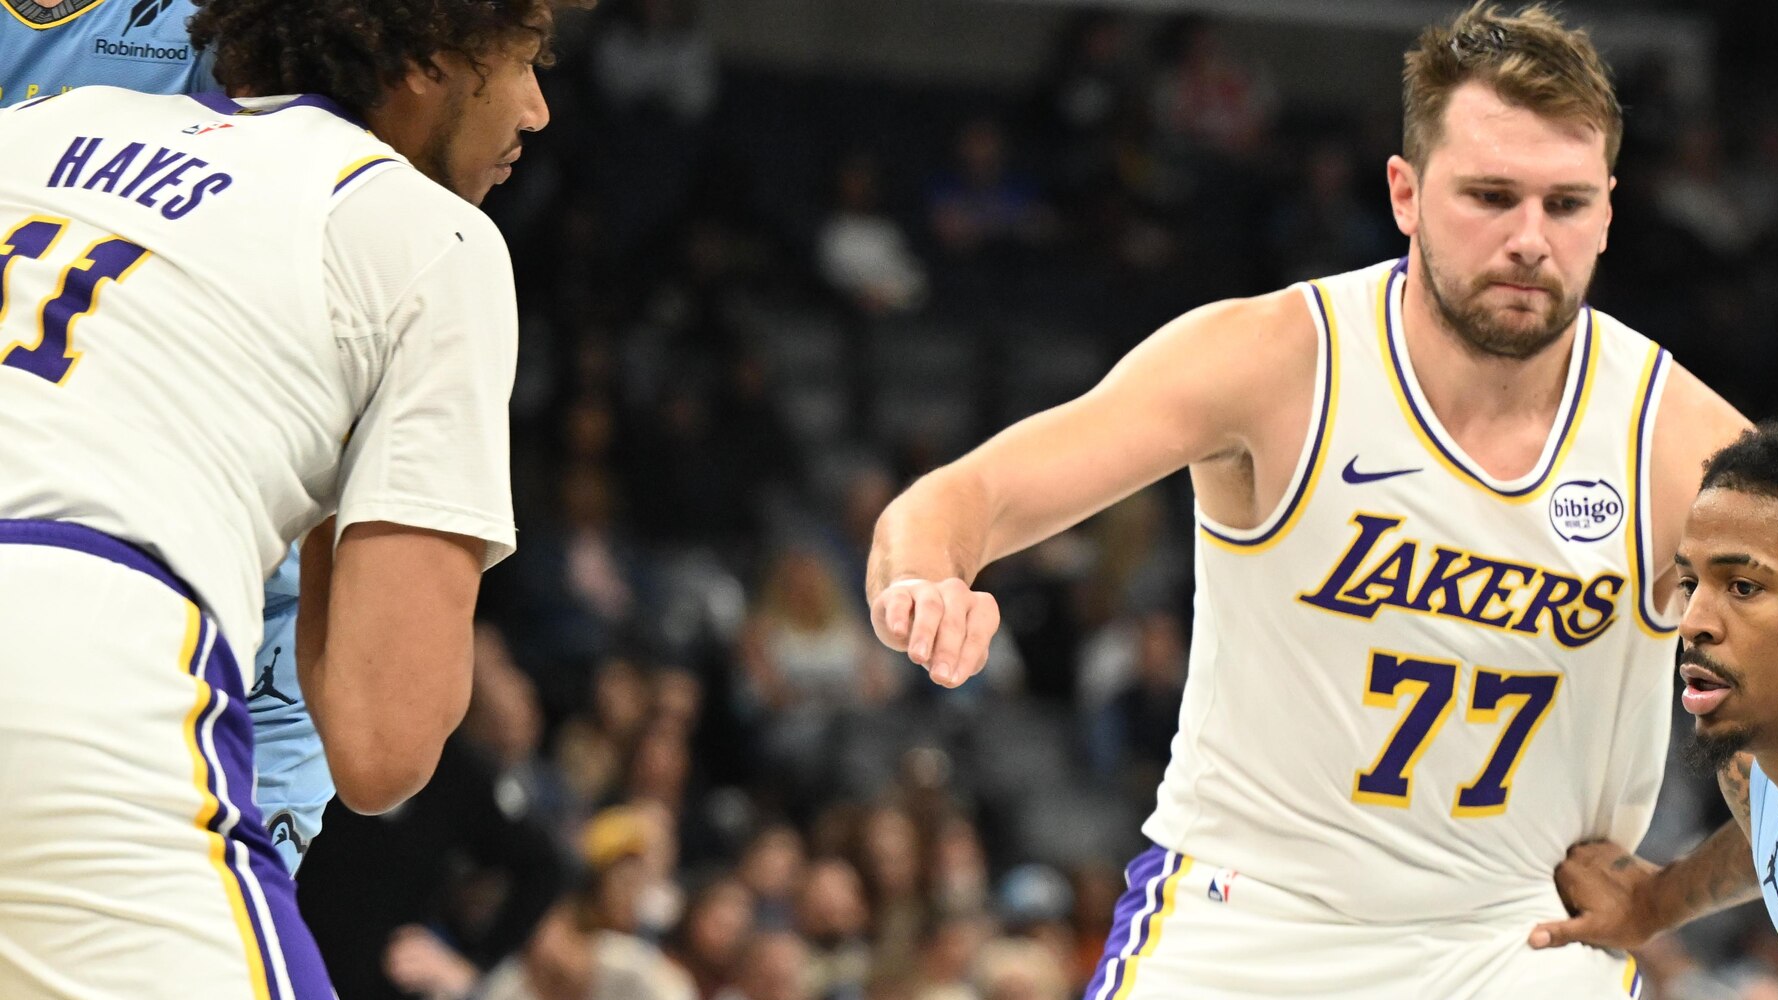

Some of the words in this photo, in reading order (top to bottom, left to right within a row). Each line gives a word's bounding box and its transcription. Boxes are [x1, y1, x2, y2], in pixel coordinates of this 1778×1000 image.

[95, 38, 189, 60] Robinhood
[46, 136, 233, 221] HAYES
[1554, 497, 1619, 523] bibigo
[1297, 510, 1629, 652] LAKERS
[1351, 647, 1565, 819] 77
